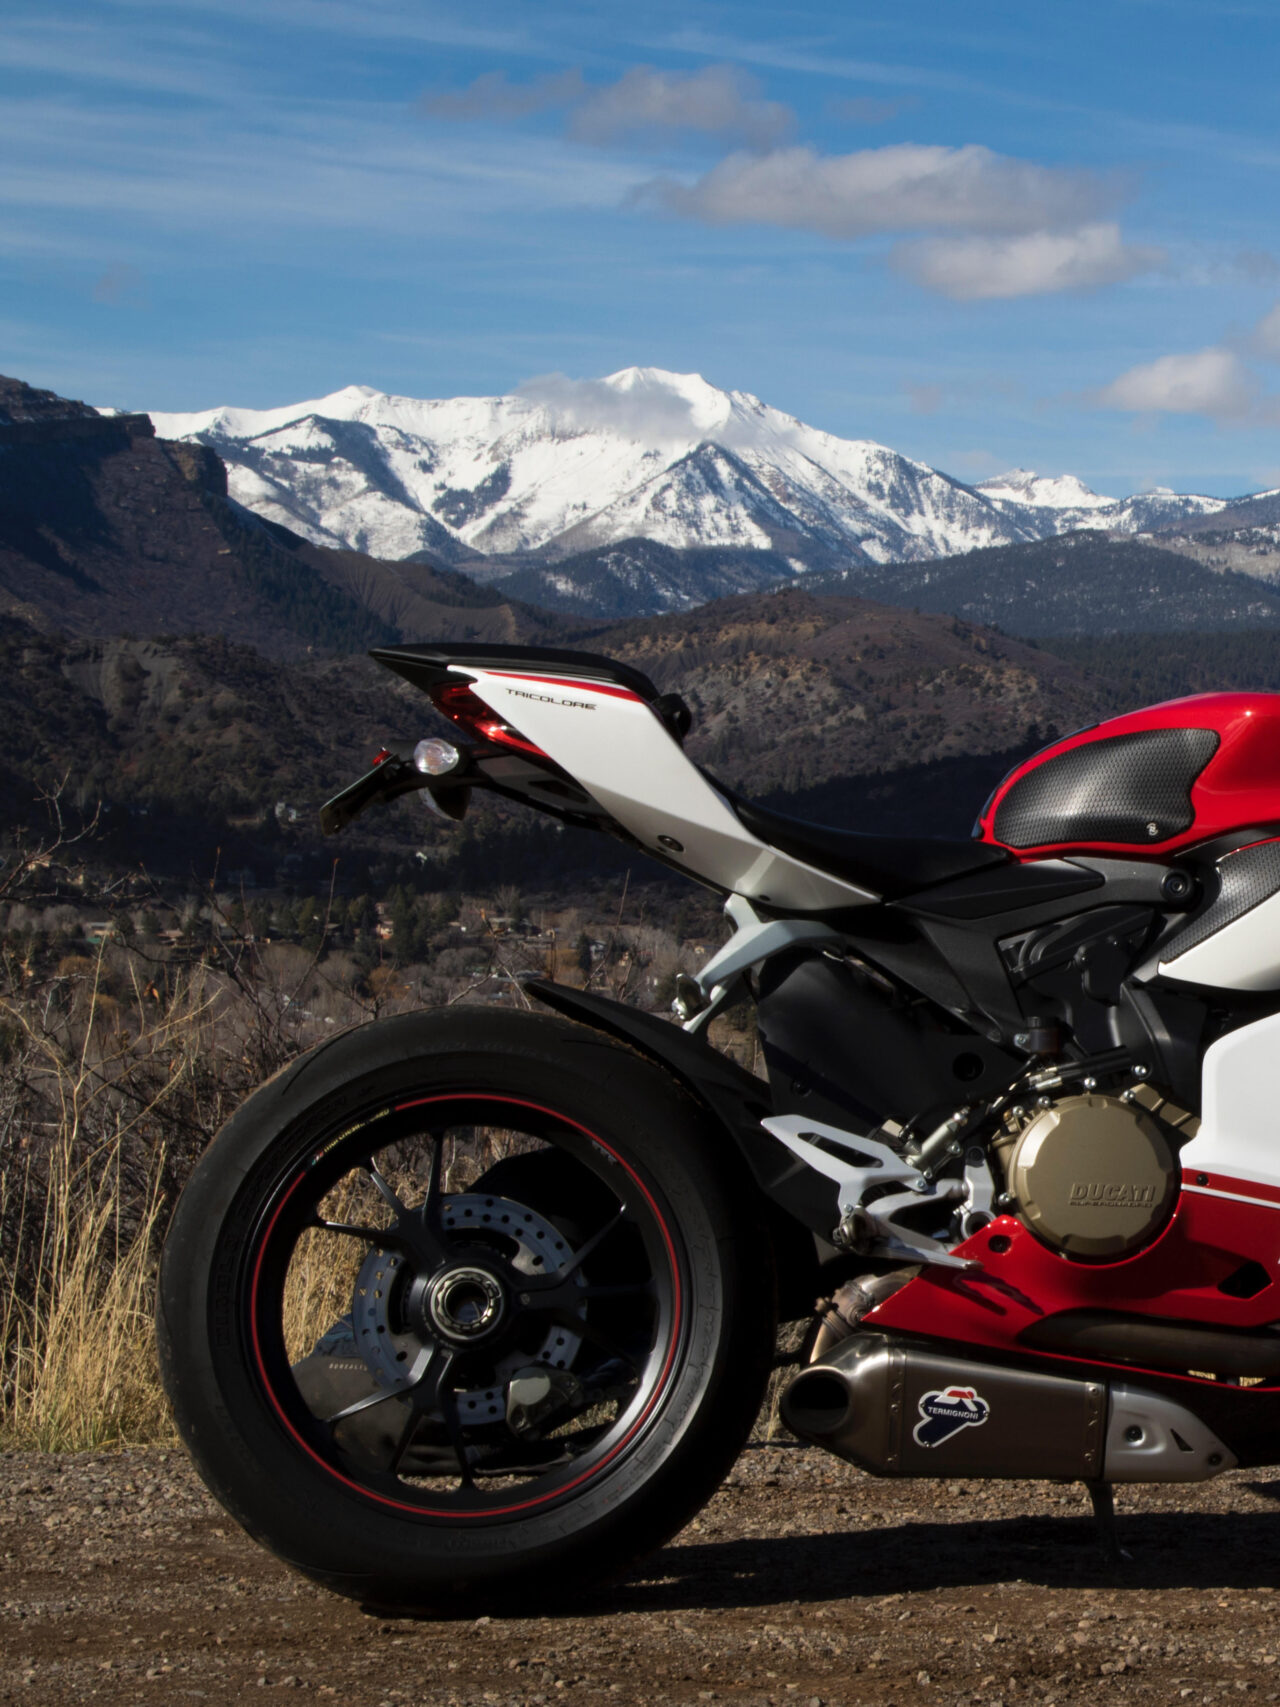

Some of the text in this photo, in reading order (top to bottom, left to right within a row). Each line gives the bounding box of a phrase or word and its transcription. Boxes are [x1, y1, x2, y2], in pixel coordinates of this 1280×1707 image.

[506, 688, 596, 710] TRICOLORE
[1070, 1183, 1156, 1202] DUCATI
[928, 1406, 979, 1420] TERMIGNONI
